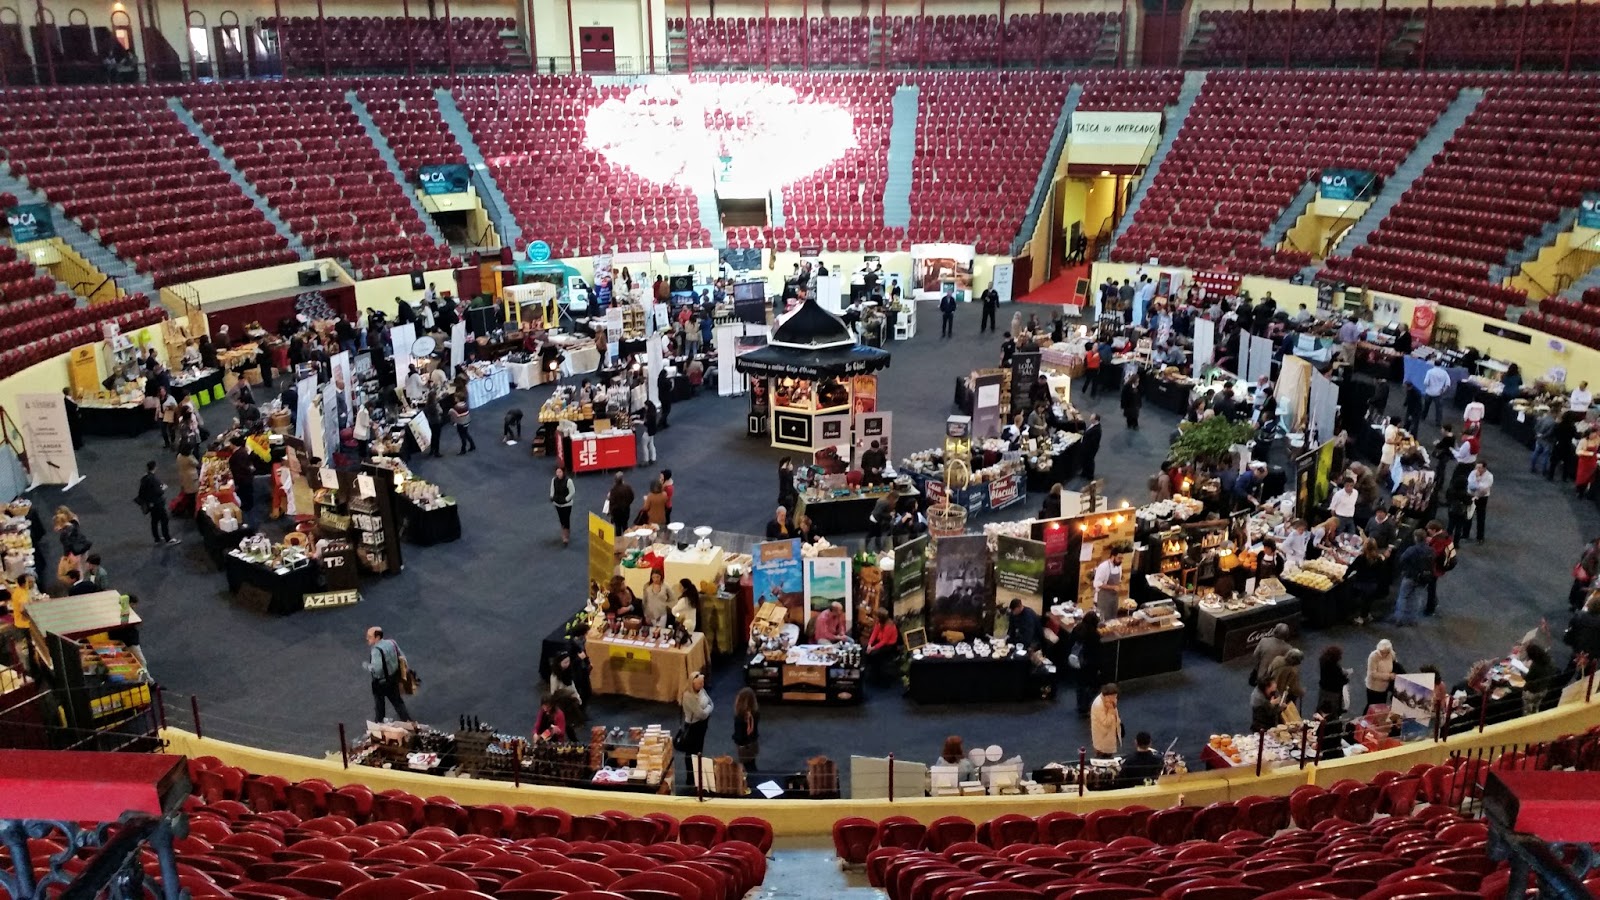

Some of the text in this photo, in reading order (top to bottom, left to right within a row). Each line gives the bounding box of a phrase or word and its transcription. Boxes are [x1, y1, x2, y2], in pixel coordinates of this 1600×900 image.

[1075, 123, 1100, 132] TASCA
[1115, 124, 1156, 133] MERCADO
[431, 172, 446, 182] CA
[1333, 175, 1348, 187] CA
[20, 212, 37, 226] CA
[304, 591, 358, 608] AZEITE
